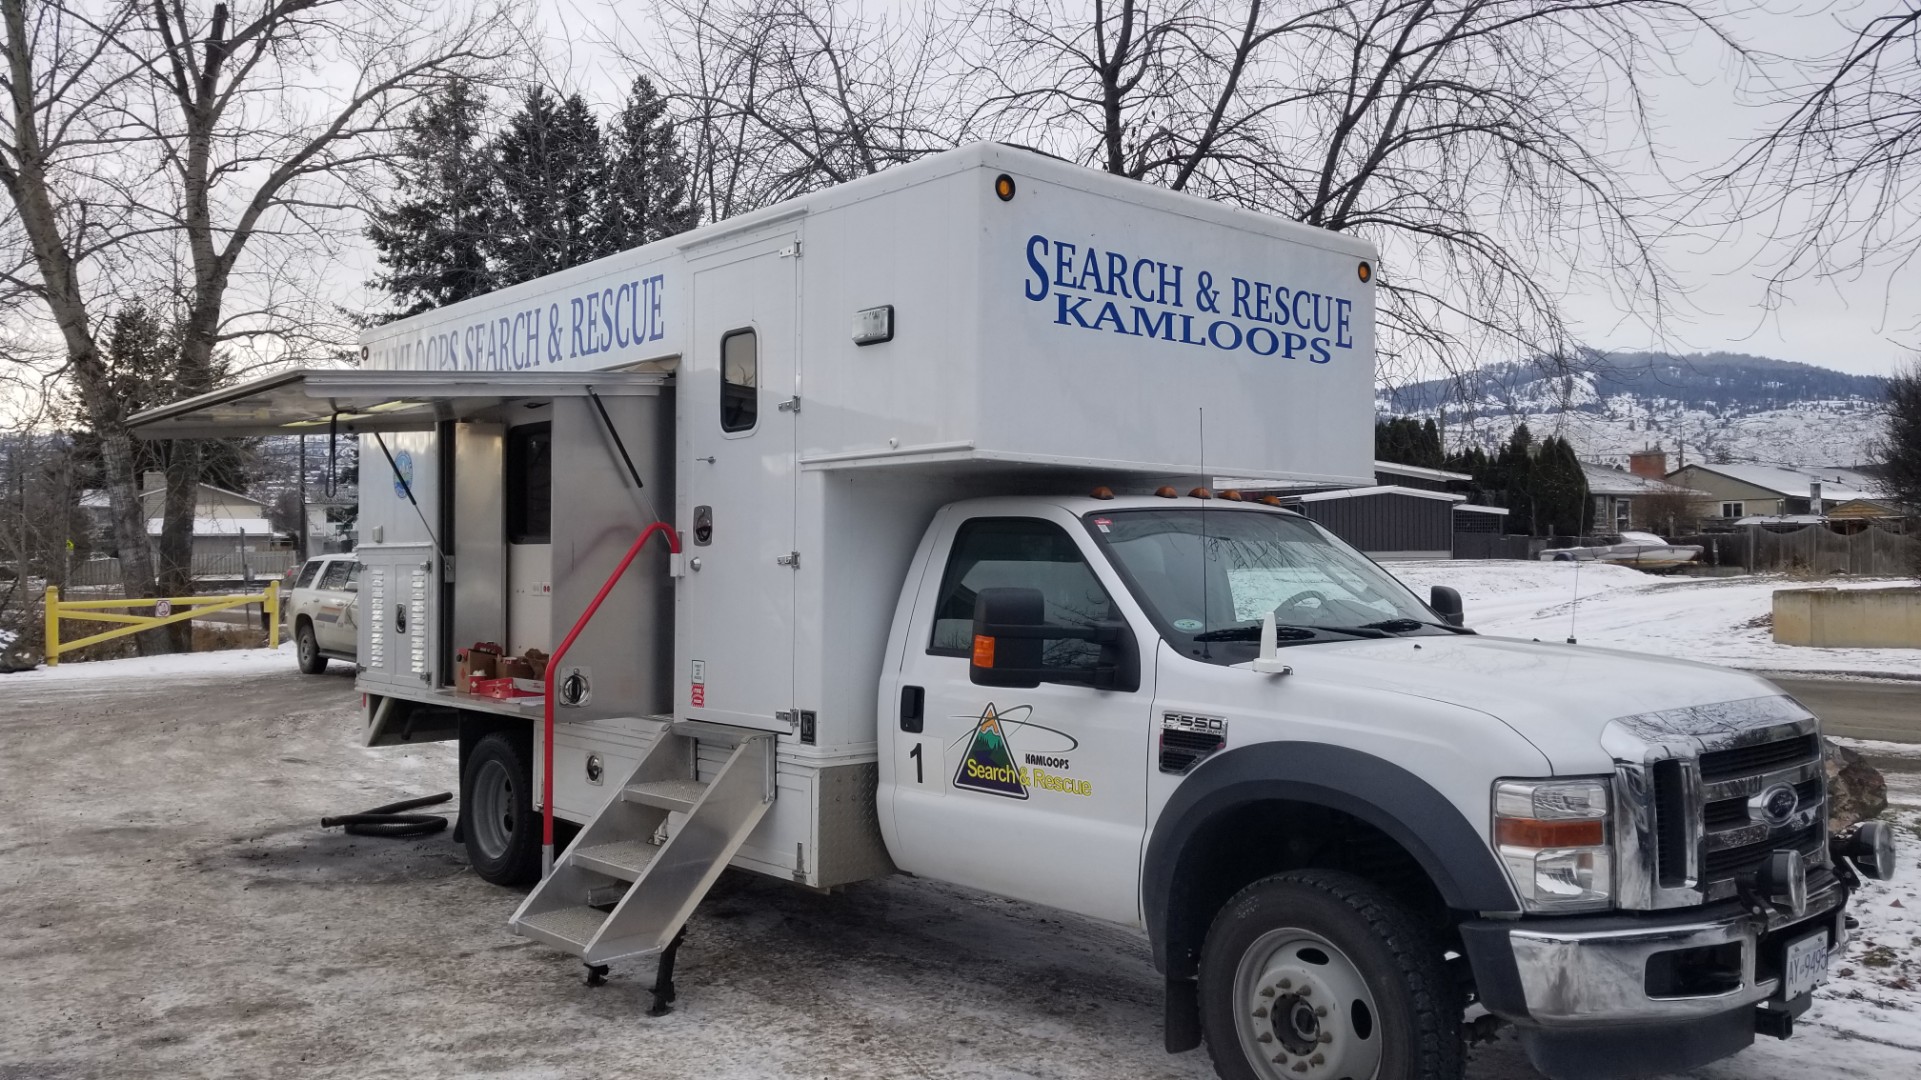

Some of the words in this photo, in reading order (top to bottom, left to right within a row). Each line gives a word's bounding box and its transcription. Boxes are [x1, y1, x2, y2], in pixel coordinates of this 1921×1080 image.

[1025, 234, 1184, 307] SEARCH
[1196, 270, 1220, 314] &
[1231, 276, 1353, 349] RESCUE
[465, 307, 541, 371] SEARCH
[547, 302, 563, 364] &
[570, 274, 664, 359] RESCUE
[1053, 292, 1332, 364] KAMLOOPS
[909, 742, 923, 784] 1
[967, 758, 1016, 784] Search
[1018, 766, 1032, 787] &
[1033, 768, 1093, 797] Rescue
[1025, 753, 1070, 770] KAMLOOPS
